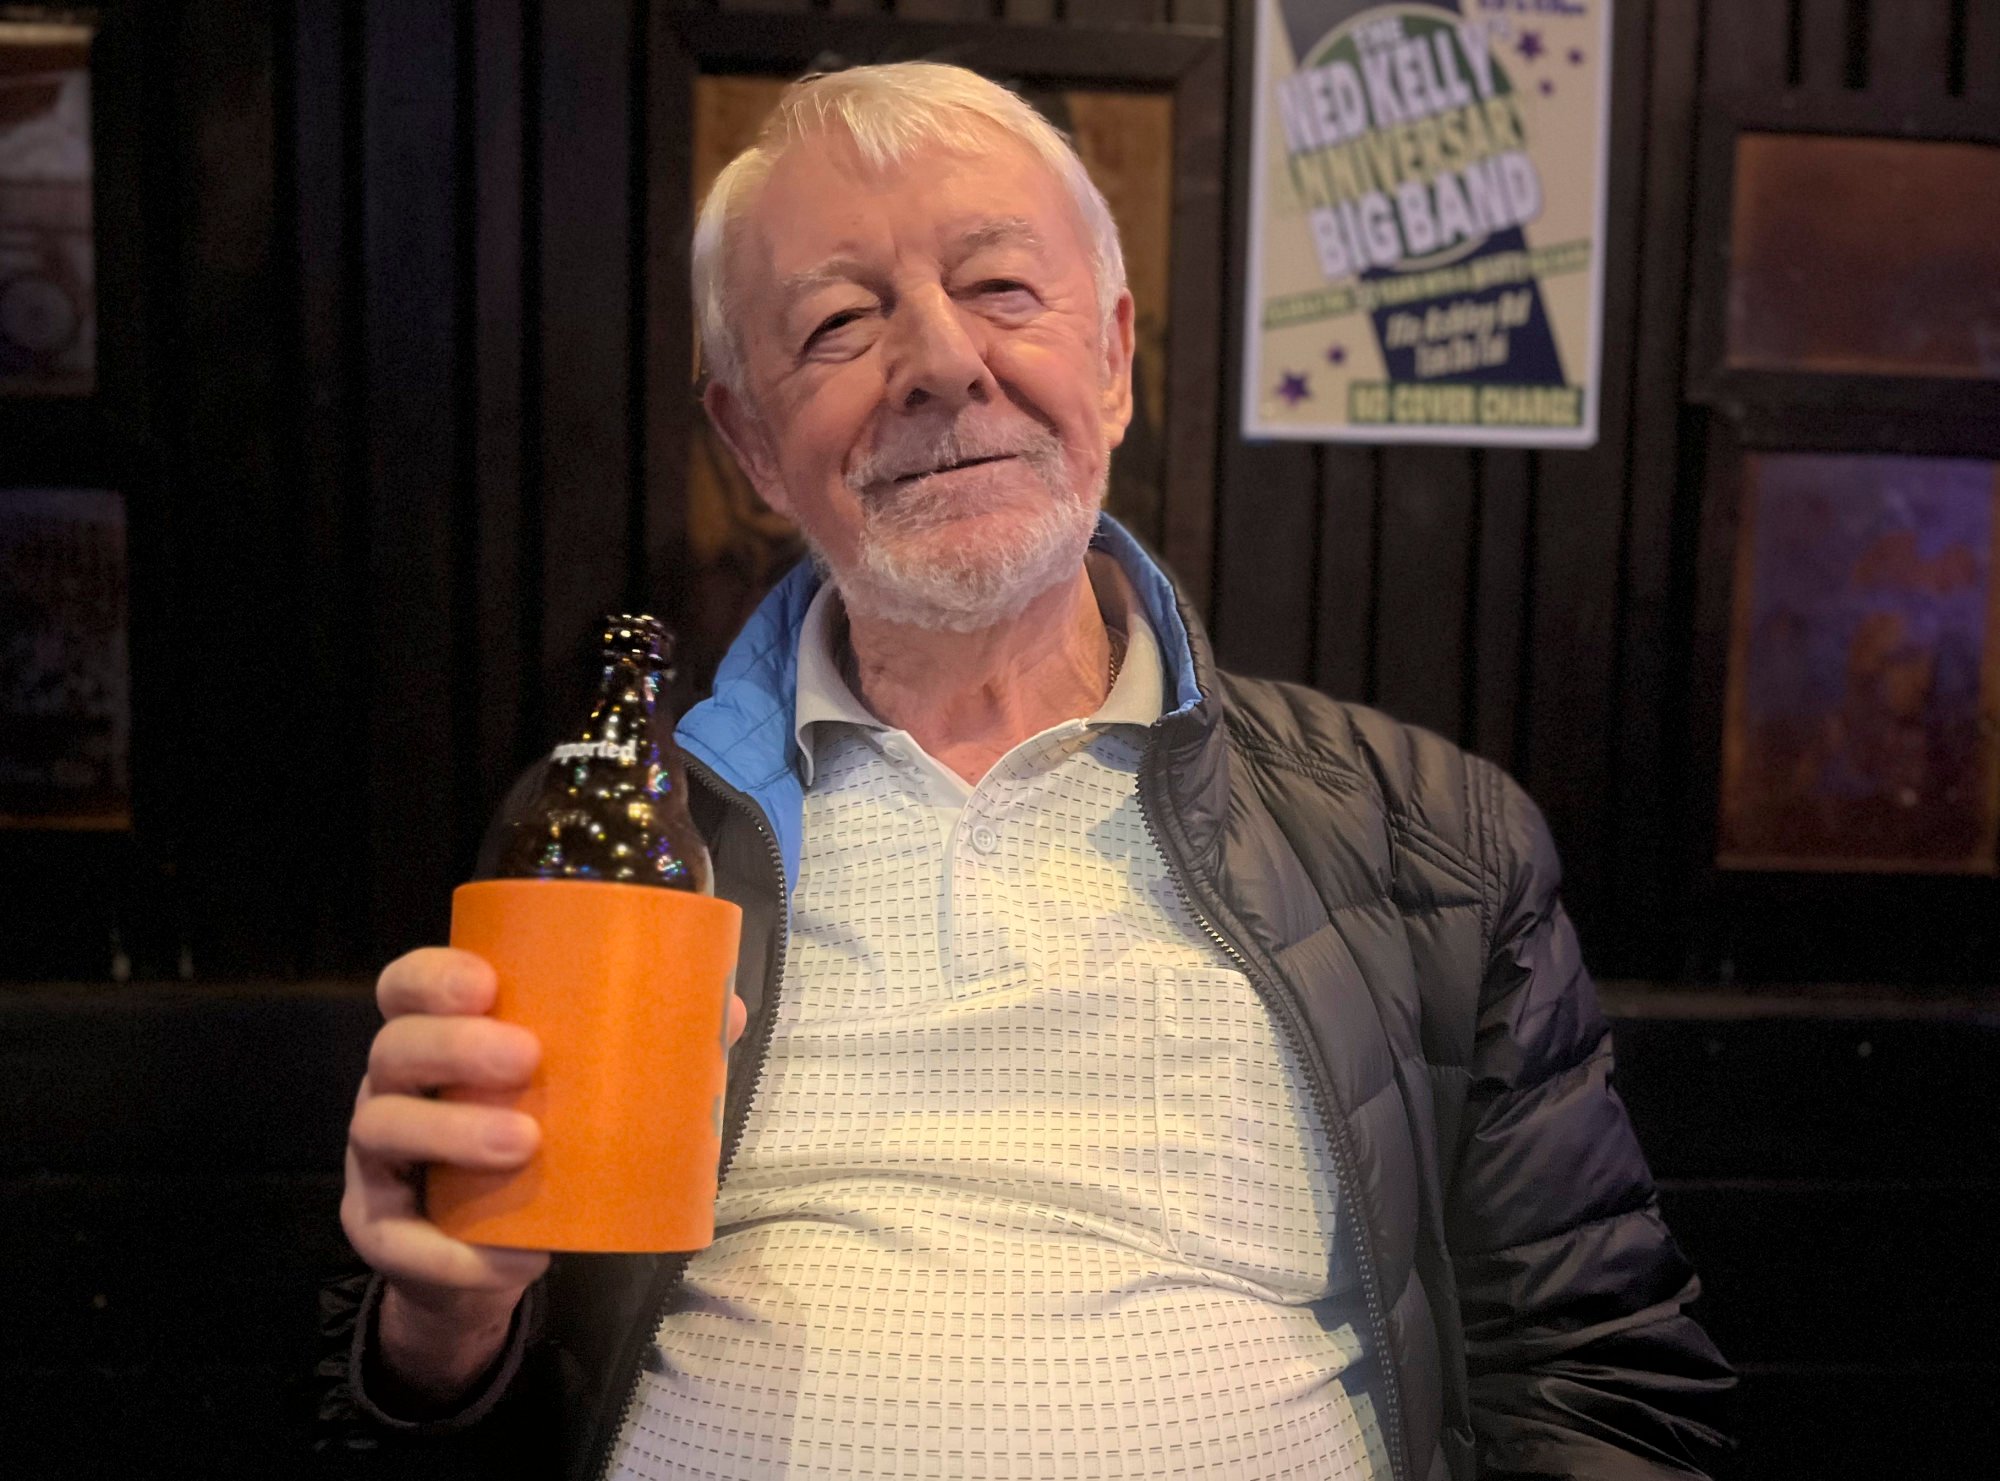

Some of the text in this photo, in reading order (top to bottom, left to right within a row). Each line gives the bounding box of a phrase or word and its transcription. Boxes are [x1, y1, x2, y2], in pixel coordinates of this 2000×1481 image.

[1277, 20, 1494, 152] NED KELLY
[1278, 97, 1528, 210] NNIVERSAR
[1310, 151, 1543, 279] BIG BAND
[1394, 385, 1475, 425] COVER
[1480, 387, 1579, 426] CHARGE
